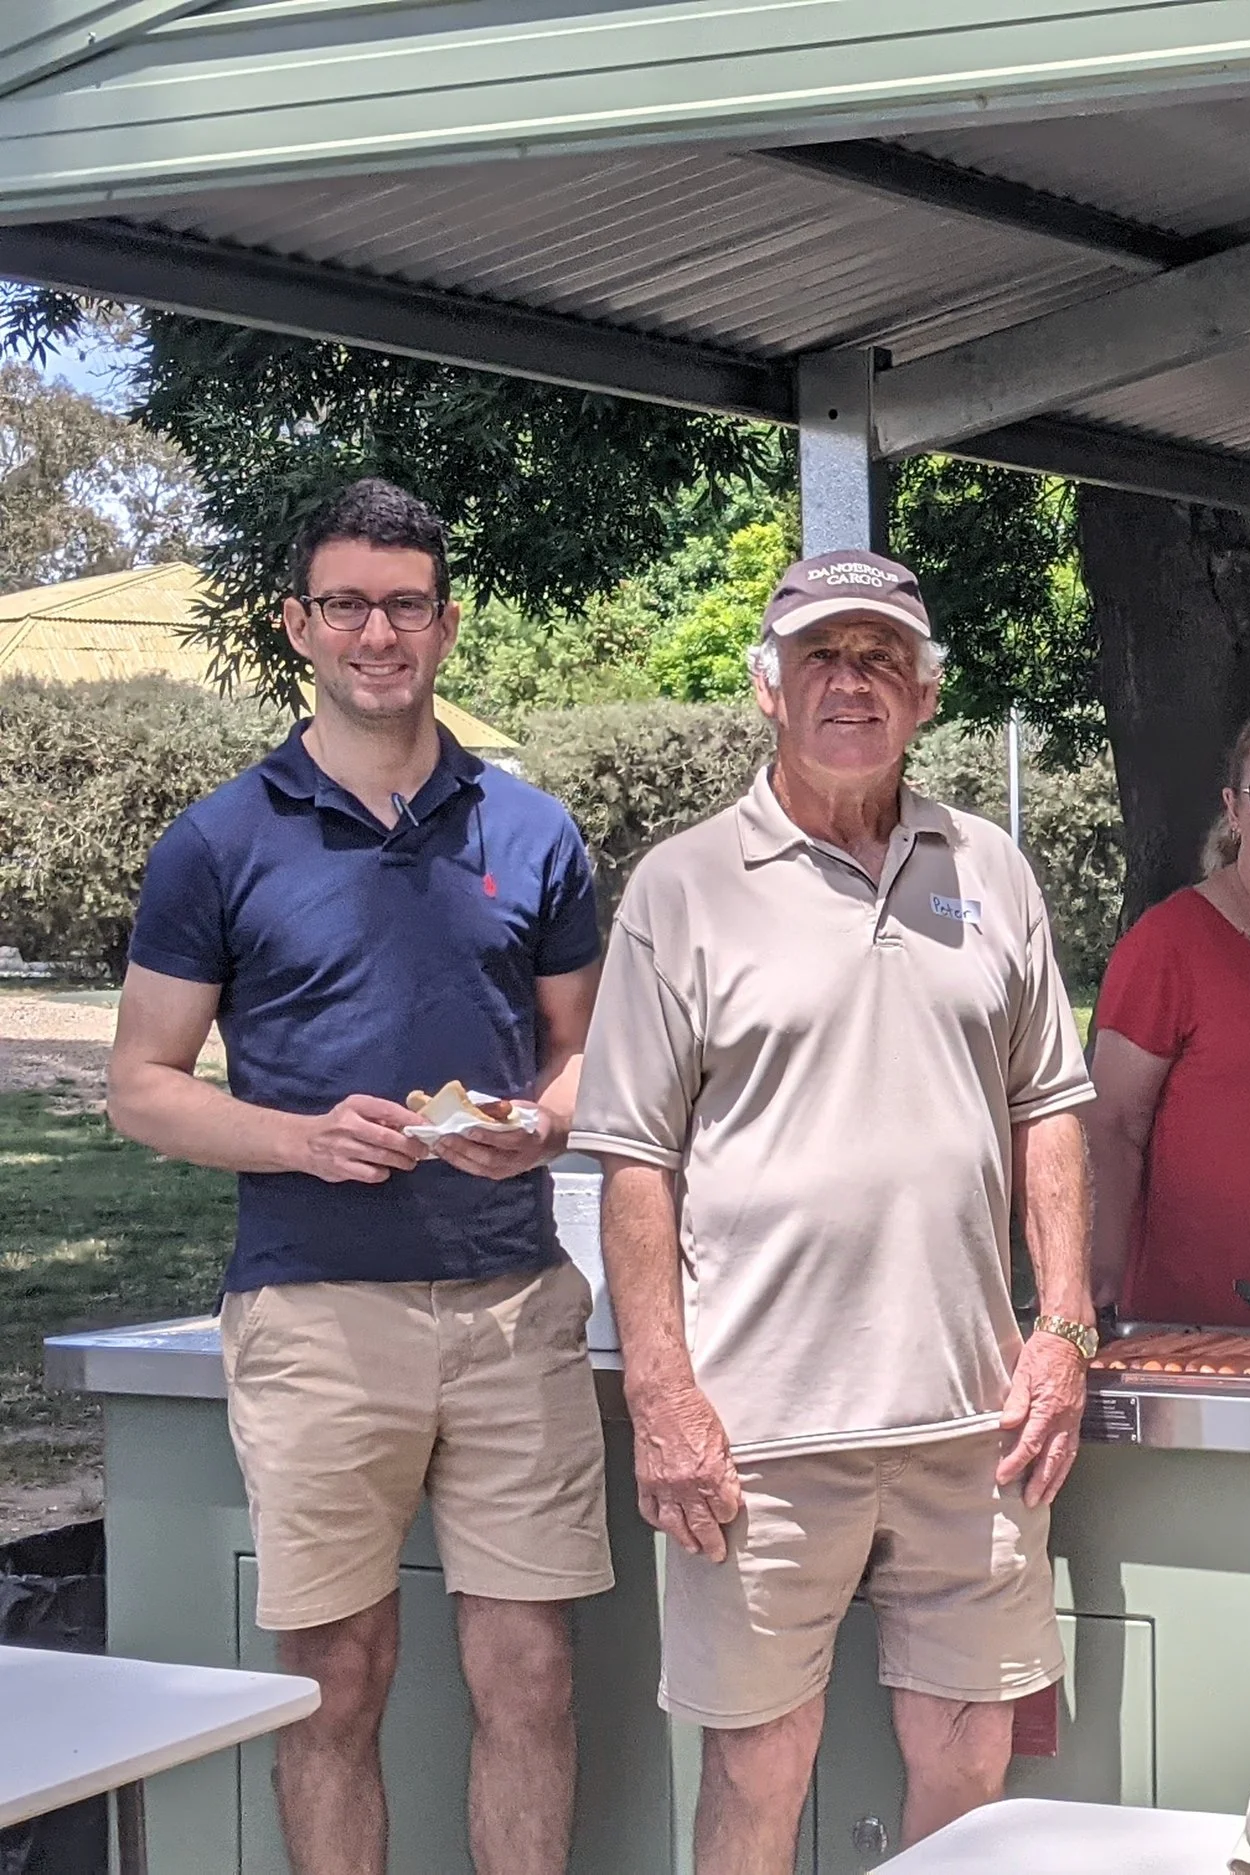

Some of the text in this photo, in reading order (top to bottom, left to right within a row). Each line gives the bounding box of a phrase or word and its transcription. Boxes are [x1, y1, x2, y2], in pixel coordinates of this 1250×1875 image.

[807, 562, 899, 583] DANGEROUS
[826, 572, 883, 588] CARGO
[932, 896, 972, 919] Peter
